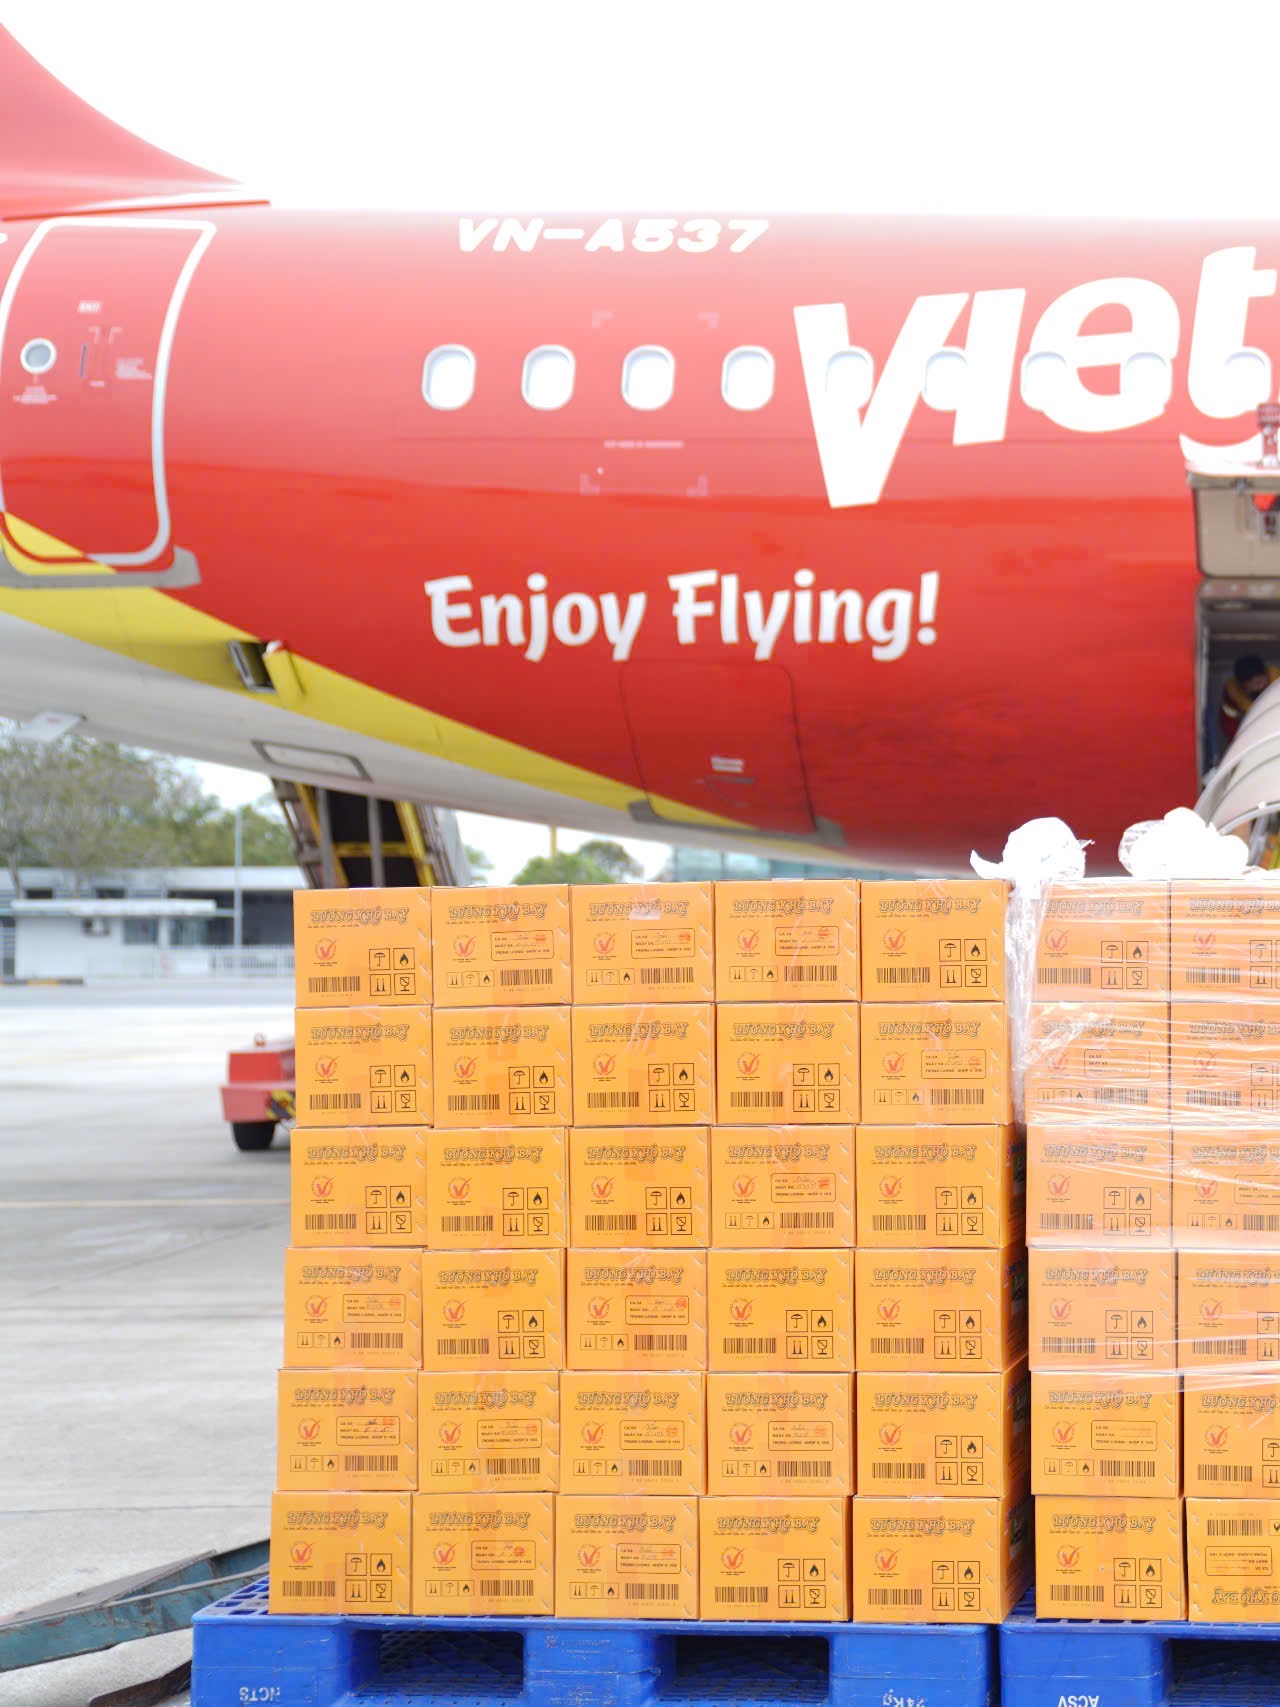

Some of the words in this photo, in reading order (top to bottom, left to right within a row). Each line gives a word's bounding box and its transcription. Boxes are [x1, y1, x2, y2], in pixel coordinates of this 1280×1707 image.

[458, 217, 769, 252] VN-A537
[424, 572, 647, 662] Enjoy
[668, 568, 940, 662] Flying!
[521, 902, 548, 920] BAY
[663, 899, 690, 917] BAY
[807, 898, 834, 915] BAY
[954, 897, 981, 915] BAY
[383, 907, 410, 924] BAY
[384, 1024, 411, 1041] BAY
[523, 1024, 550, 1042] BAY
[662, 1021, 689, 1039] BAY
[808, 1021, 835, 1039] BAY
[954, 1020, 981, 1038] BAY
[380, 1144, 406, 1162] BAY
[517, 1145, 544, 1163] BAY
[660, 1144, 687, 1162] BAY
[803, 1144, 830, 1162] BAY
[950, 1144, 977, 1162] BAY
[375, 1265, 401, 1282] BAY
[512, 1268, 539, 1286] BAY
[658, 1267, 685, 1284] BAY
[801, 1267, 828, 1285] BAY
[949, 1268, 976, 1285] BAY
[369, 1387, 396, 1405] BAY
[510, 1390, 537, 1408] BAY
[652, 1392, 679, 1409] BAY
[801, 1392, 828, 1409] BAY
[951, 1393, 978, 1411] BAY
[1125, 1392, 1152, 1410] BAY
[362, 1511, 389, 1528] BAY
[504, 1512, 531, 1529] BAY
[650, 1514, 677, 1532] BAY
[793, 1516, 820, 1533] BAY
[948, 1518, 975, 1536] BAY
[1129, 1515, 1156, 1533] BAY
